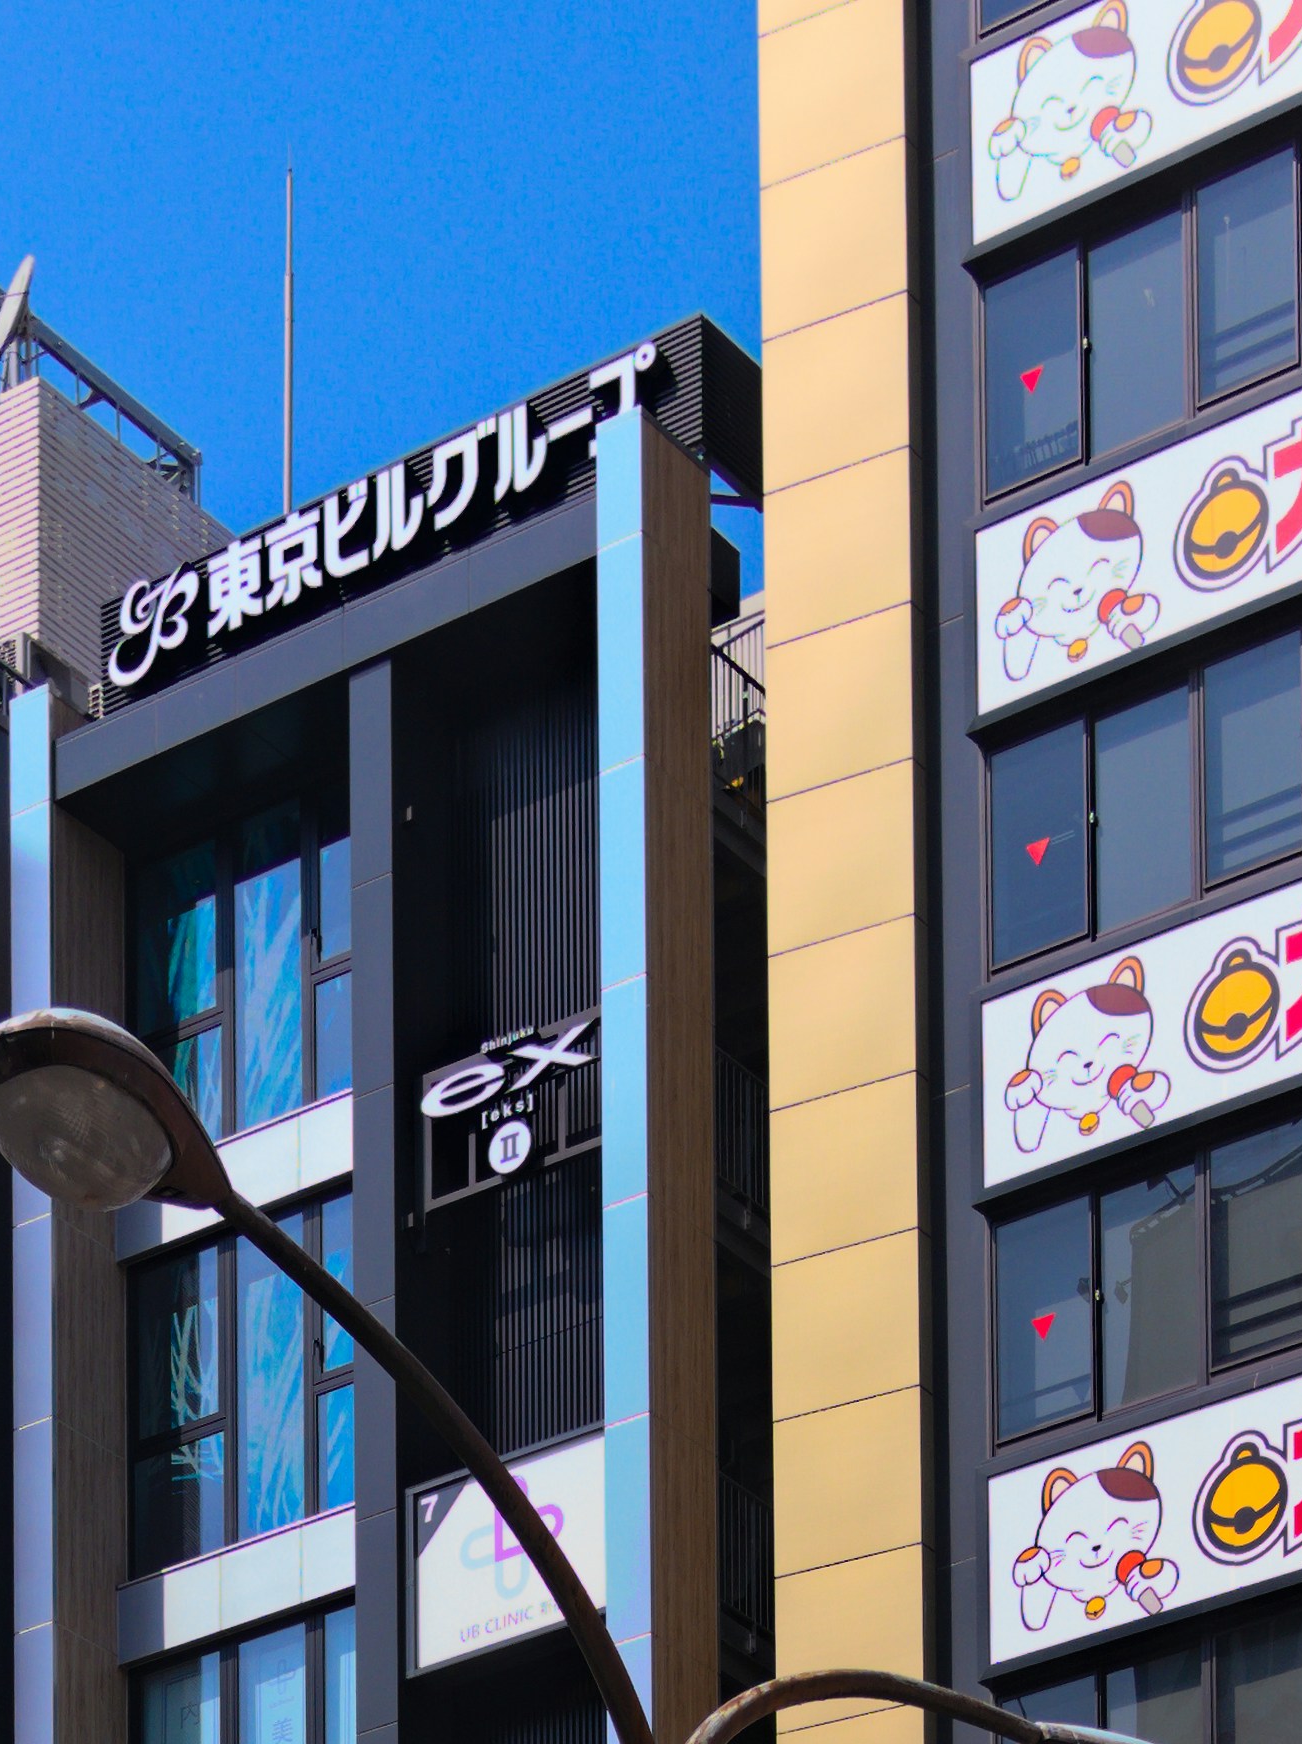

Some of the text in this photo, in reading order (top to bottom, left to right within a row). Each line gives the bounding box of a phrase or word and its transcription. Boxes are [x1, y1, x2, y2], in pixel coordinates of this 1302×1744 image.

[208, 343, 657, 638] 東京ビルグループ
[480, 1026, 535, 1055] Shinjuku
[420, 1020, 594, 1118] ex
[418, 1494, 440, 1524] 7
[459, 1622, 482, 1644] UB
[484, 1607, 534, 1639] CLINIC
